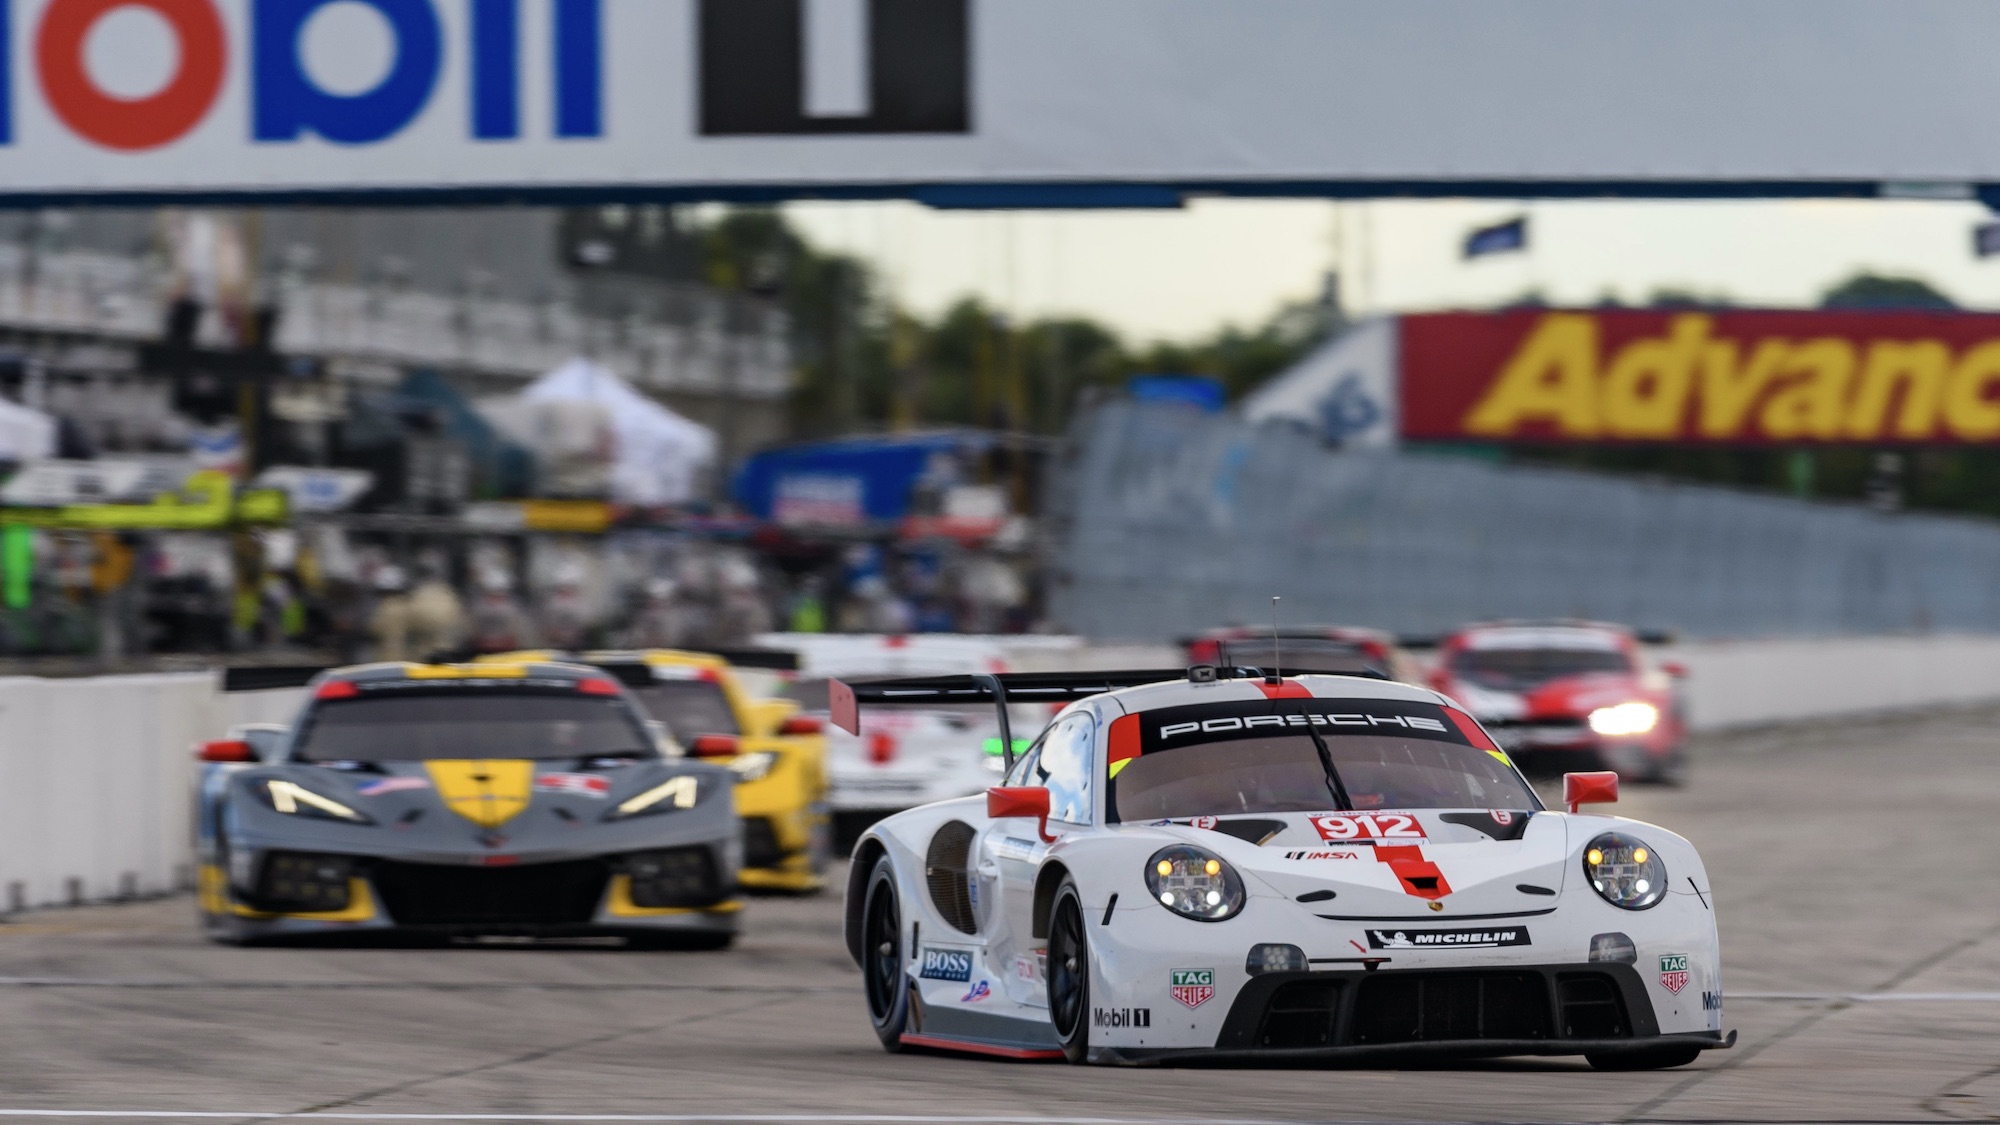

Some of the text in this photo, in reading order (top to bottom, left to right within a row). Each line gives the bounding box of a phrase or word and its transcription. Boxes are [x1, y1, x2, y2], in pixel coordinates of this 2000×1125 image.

[0, 0, 602, 153] obil
[1160, 714, 1448, 739] PORSCHE
[1318, 815, 1421, 838] 912
[1415, 931, 1517, 944] MICHELIN
[926, 951, 969, 972] BOSS
[1662, 958, 1686, 970] TAG
[1175, 972, 1210, 984] TAG
[1662, 973, 1687, 991] HEUER
[1174, 987, 1210, 1005] HEUER
[1095, 1008, 1130, 1027] Mobil
